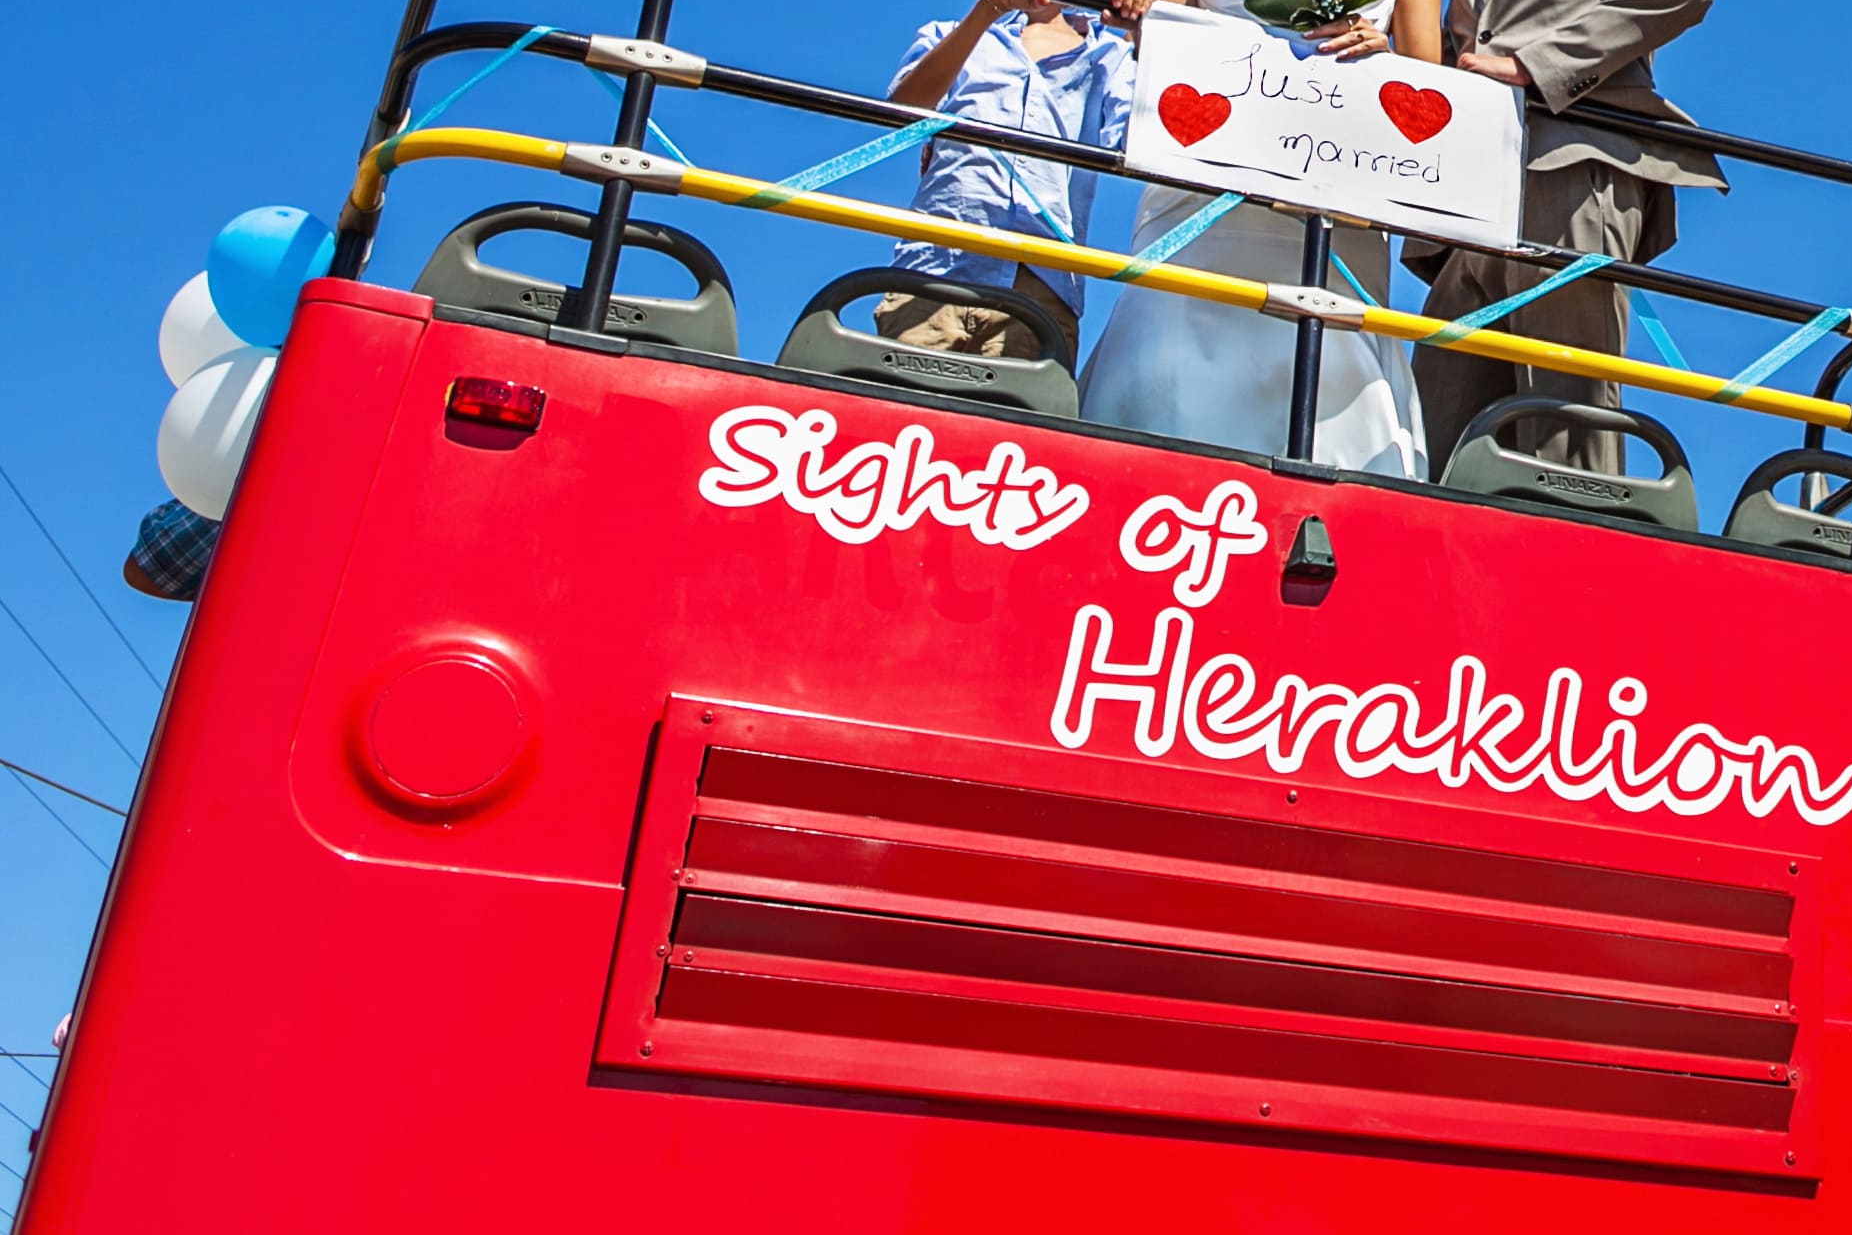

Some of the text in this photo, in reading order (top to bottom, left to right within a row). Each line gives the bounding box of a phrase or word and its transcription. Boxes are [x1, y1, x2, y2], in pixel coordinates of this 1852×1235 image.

[1220, 43, 1344, 109] Just
[1278, 133, 1441, 183] married
[1120, 480, 1268, 607] of
